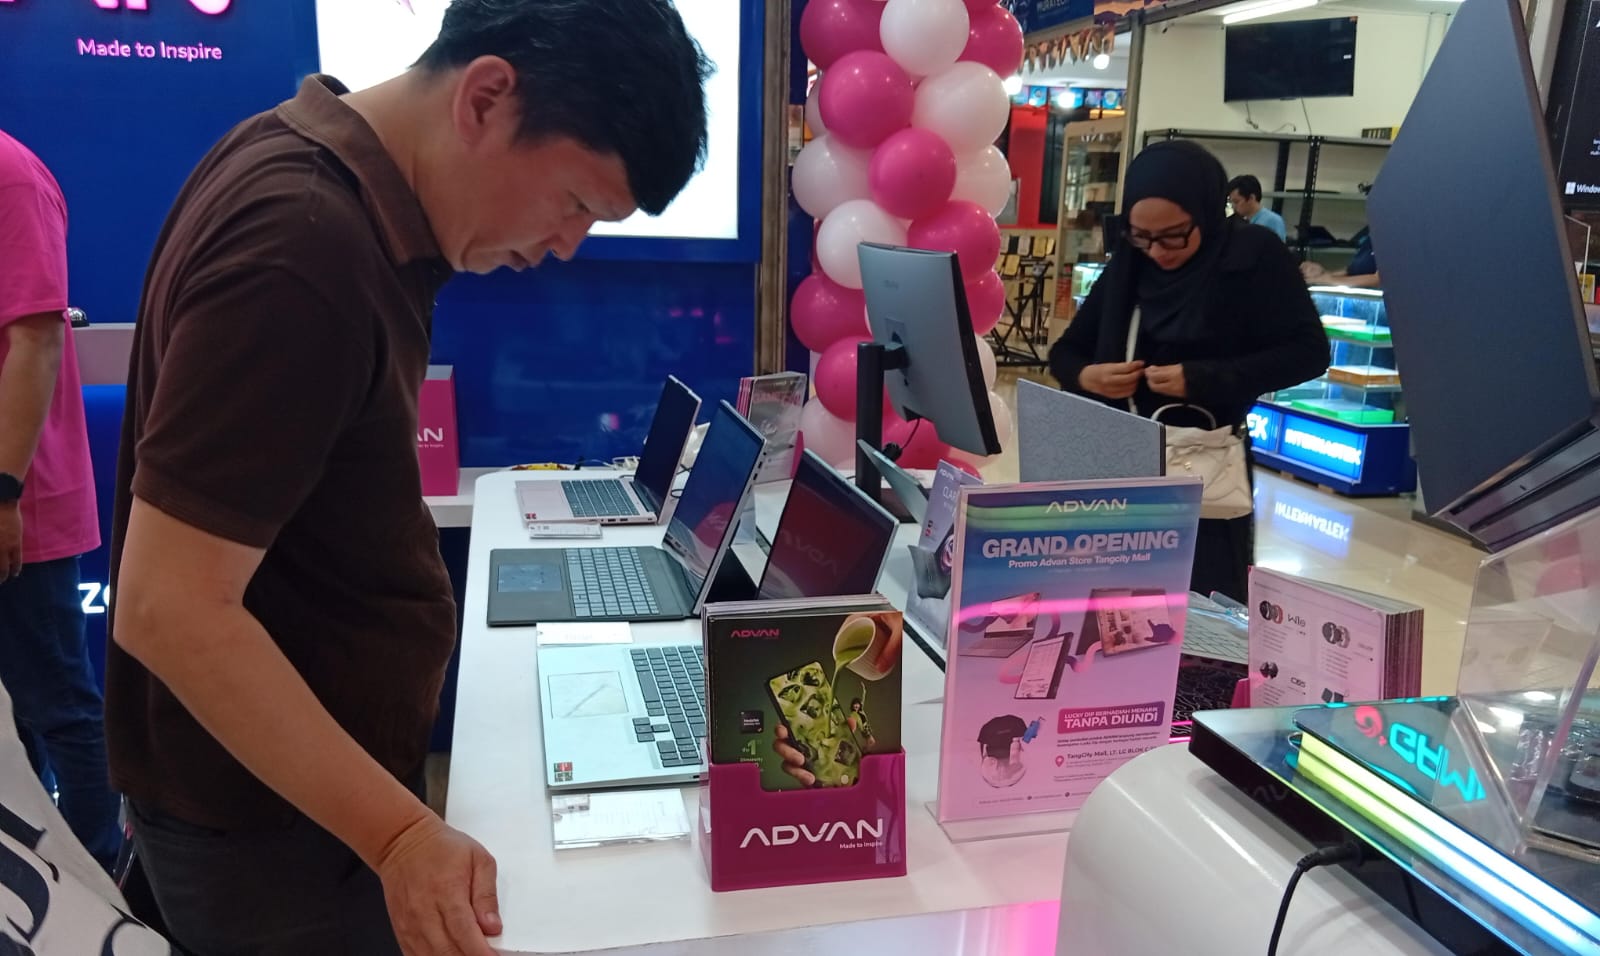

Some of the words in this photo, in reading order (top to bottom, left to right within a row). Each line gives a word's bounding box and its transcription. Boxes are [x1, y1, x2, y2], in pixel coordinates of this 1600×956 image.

[77, 38, 131, 57] Made
[136, 42, 156, 58] to
[160, 41, 222, 62] Inspire
[1046, 498, 1127, 513] ADVAN
[982, 535, 1068, 559] GRAND
[1073, 529, 1179, 553] OPENING
[1008, 559, 1038, 569] Promo
[1039, 557, 1067, 568] Advan
[1069, 555, 1093, 566] Store
[1131, 552, 1151, 562] Mall
[731, 629, 780, 639] ADVAN
[1064, 716, 1108, 729] TANPA
[1111, 711, 1158, 725] DIUNDI
[740, 818, 883, 848] ADVAN
